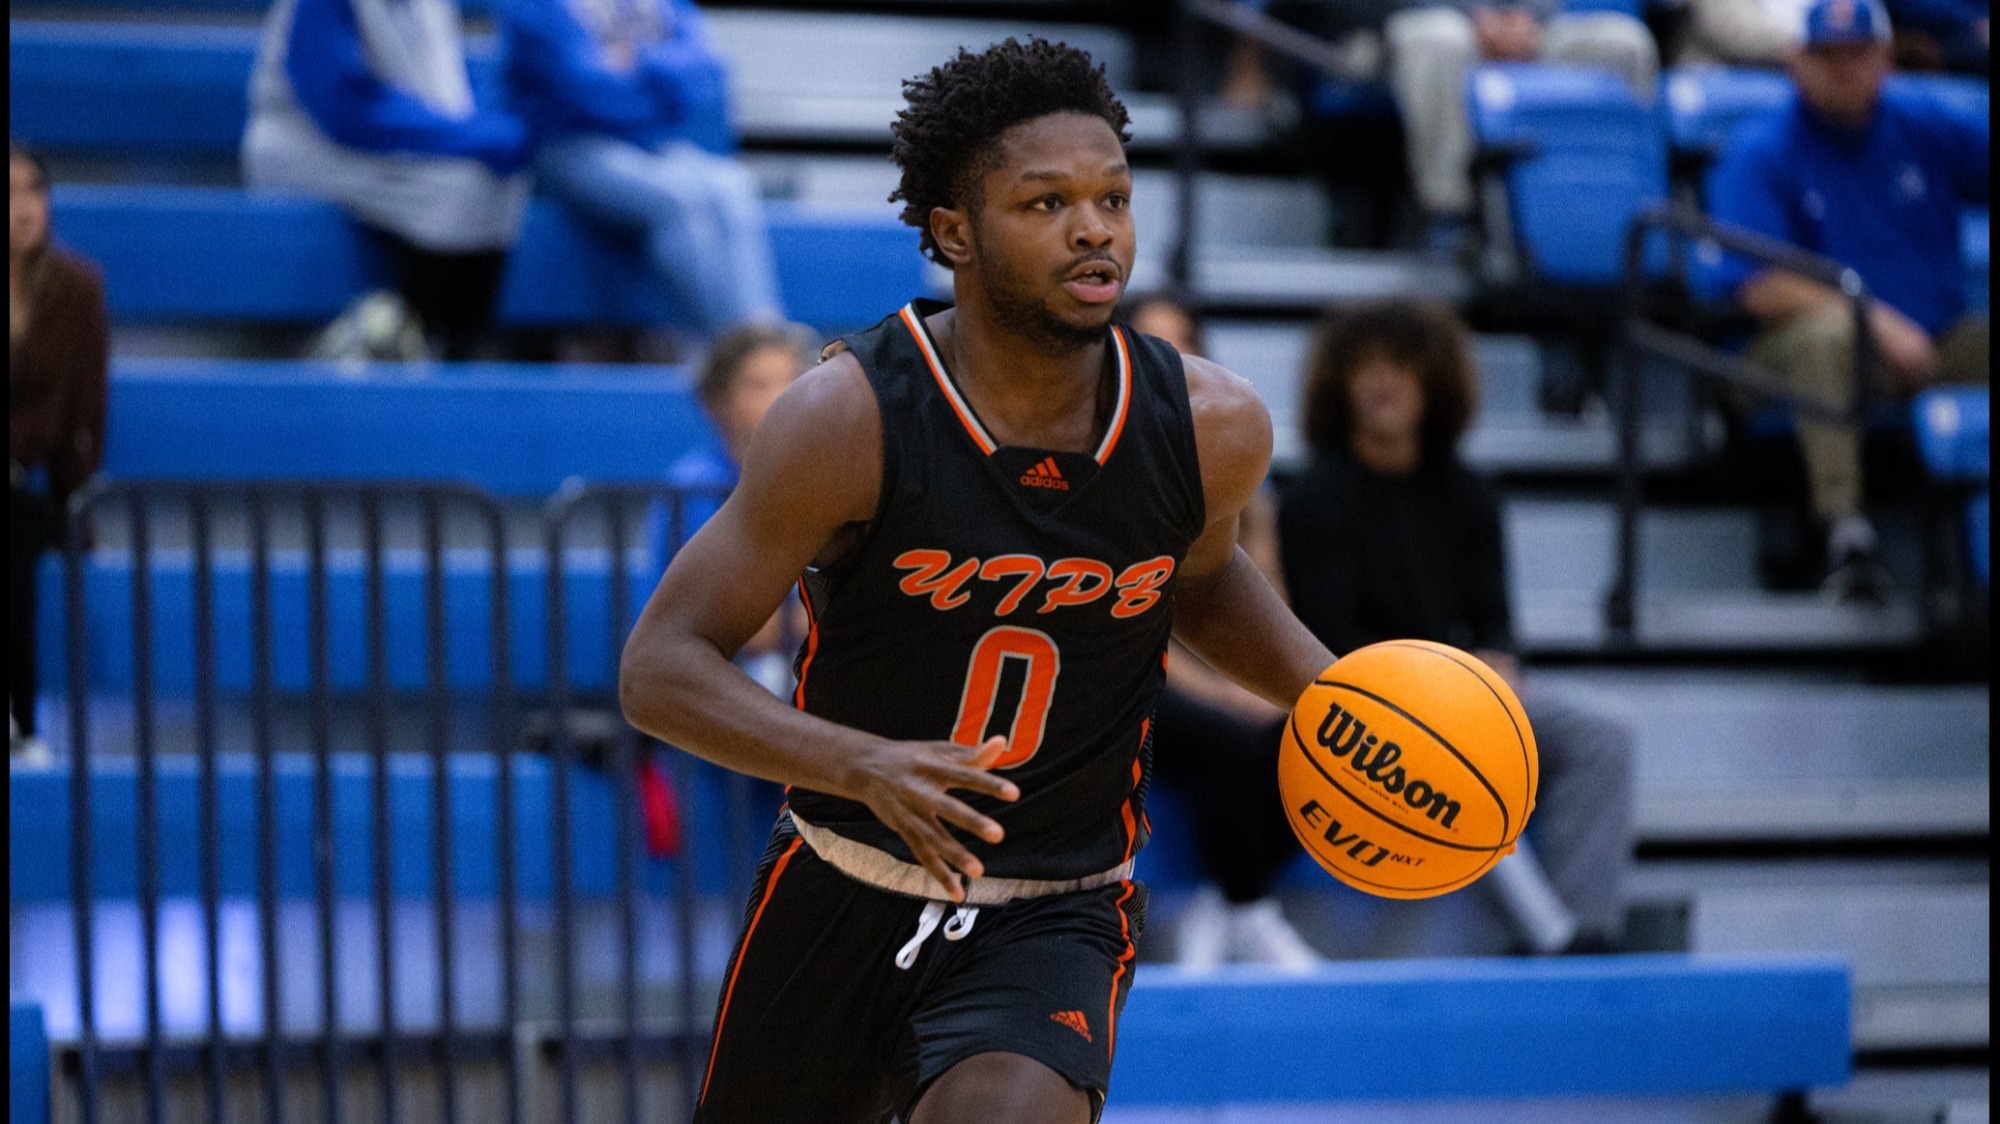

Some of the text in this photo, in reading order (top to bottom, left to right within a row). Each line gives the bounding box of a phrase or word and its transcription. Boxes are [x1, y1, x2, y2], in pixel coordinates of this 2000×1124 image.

[1020, 475, 1069, 490] adidas
[893, 549, 1175, 618] UTPB
[950, 625, 1060, 770] 0
[1317, 702, 1461, 829] Wilson
[1300, 799, 1425, 867] EVO NXT
